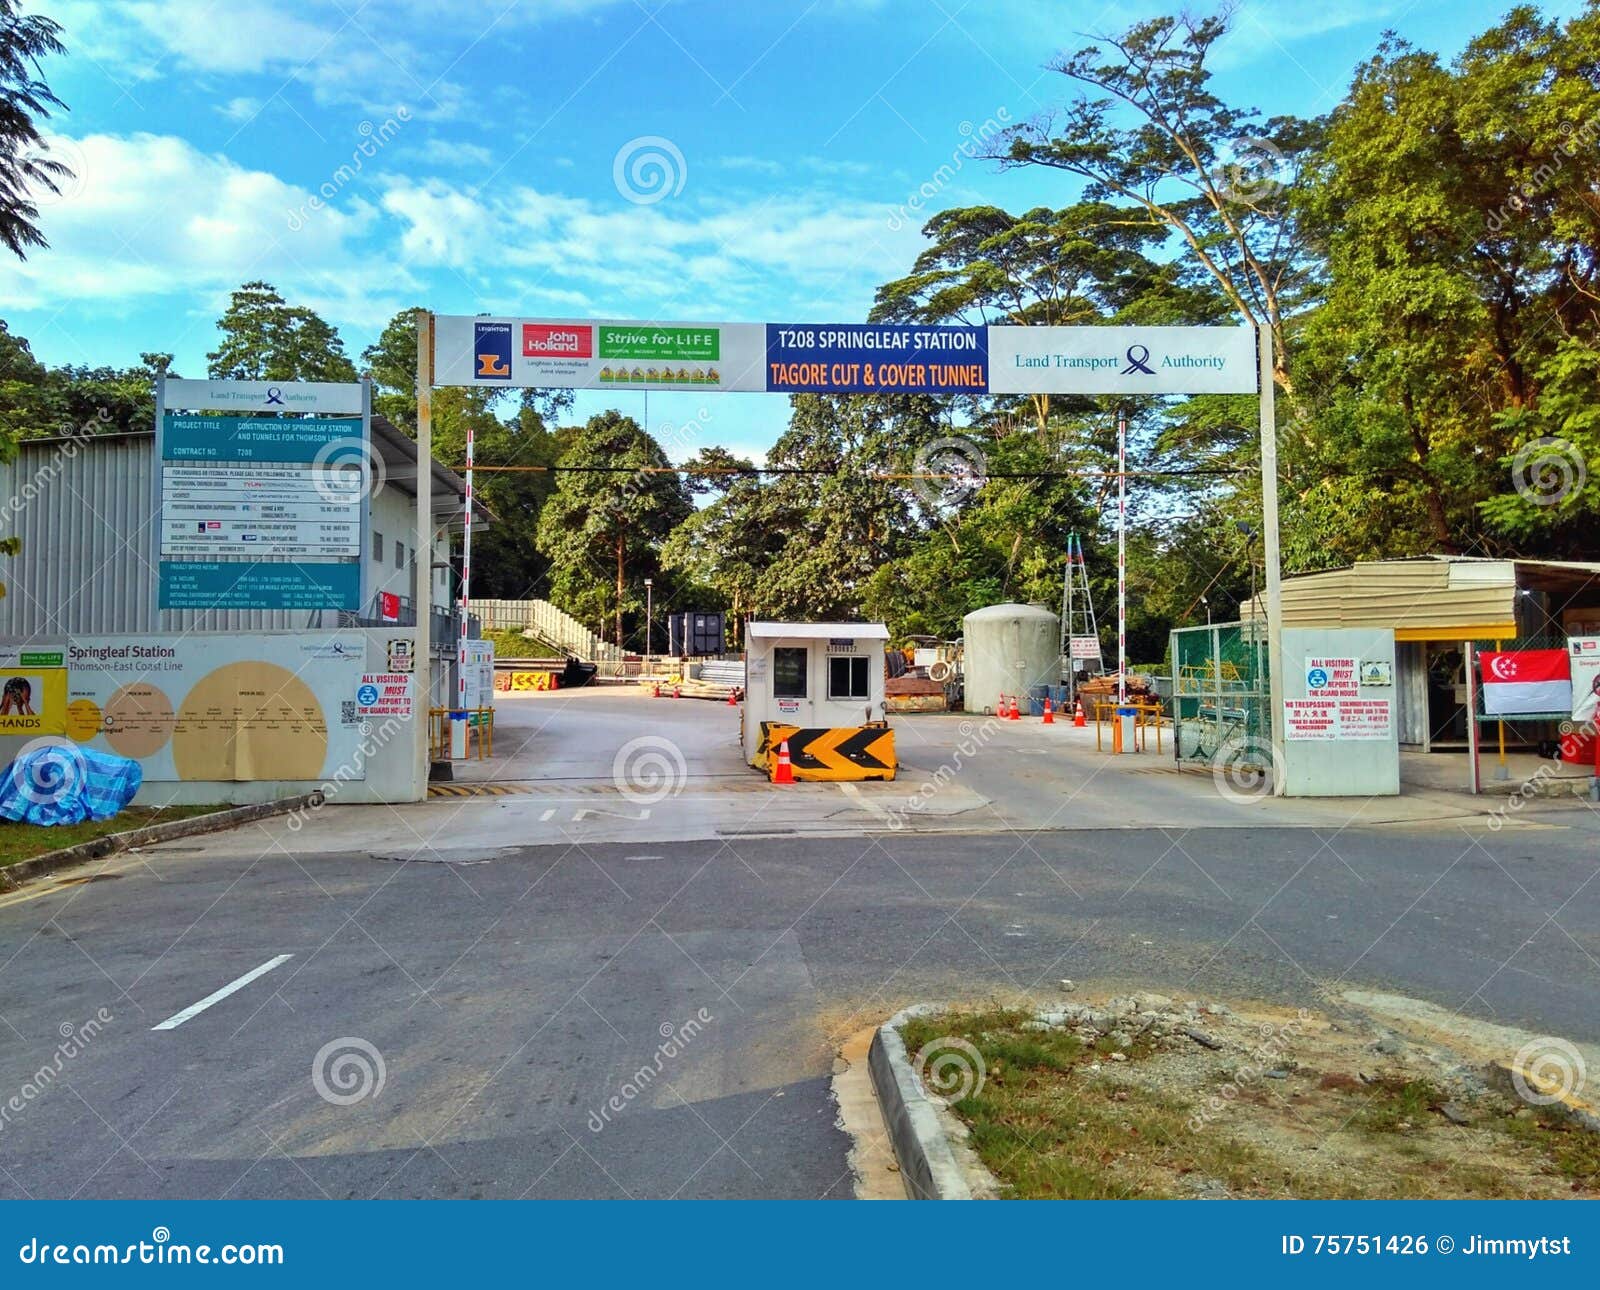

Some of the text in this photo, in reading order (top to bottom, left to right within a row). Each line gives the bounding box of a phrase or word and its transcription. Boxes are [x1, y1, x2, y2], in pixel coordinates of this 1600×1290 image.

[547, 331, 578, 343] John
[606, 332, 648, 344] Strive
[652, 333, 673, 345] for
[779, 330, 976, 350] T208 SPRINGLEAF STATION
[528, 340, 578, 351] Holland
[1015, 354, 1226, 372] Land Transport Authority
[771, 363, 986, 387] TAGORE CUT & COVER TUNNEL
[173, 421, 201, 429] PROJECT
[203, 422, 220, 430] TITLE
[237, 423, 282, 431] CONSTRUCTION
[292, 424, 327, 432] SPRINGLEAF
[328, 425, 352, 433] STATION
[252, 433, 280, 441] TUNNELS
[296, 434, 326, 442] THOMSON
[173, 447, 206, 455] CONTRACT
[237, 448, 253, 456] T208
[69, 645, 175, 660] Springleaf Station
[69, 661, 183, 671] Thomson-East Coast Line
[1311, 659, 1354, 667] ALL VISITORS
[362, 675, 409, 683] ALL VISITORS
[1333, 670, 1354, 679] MUST
[384, 686, 407, 695] MUST
